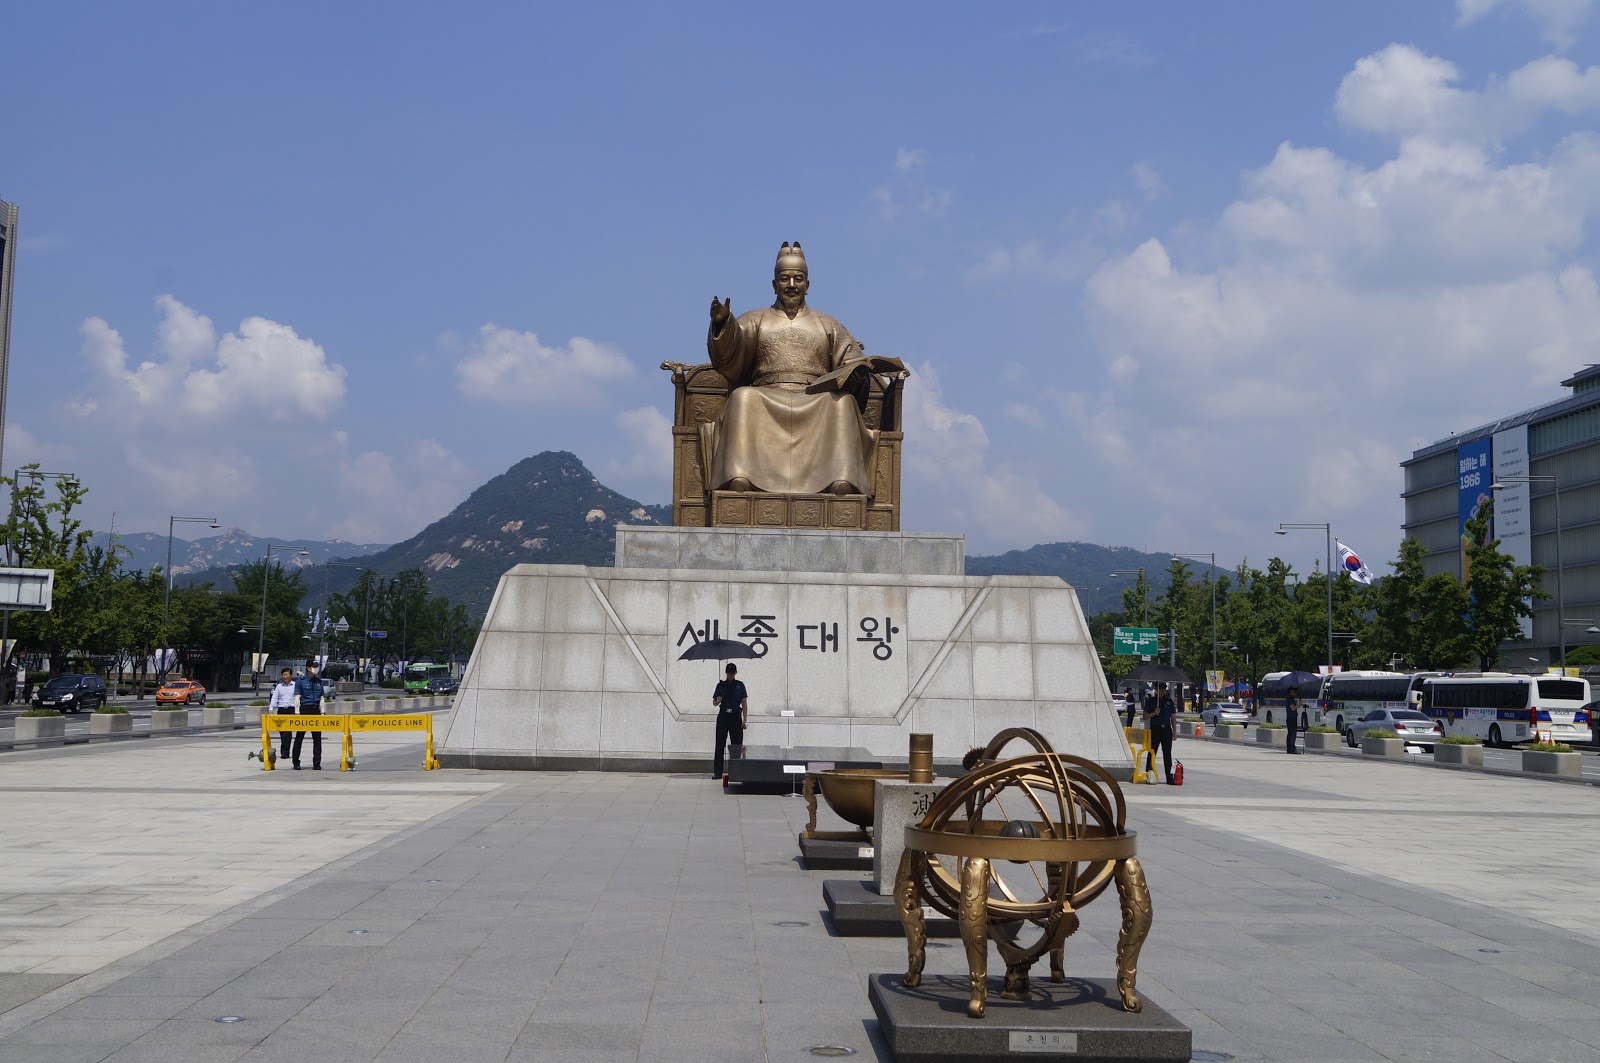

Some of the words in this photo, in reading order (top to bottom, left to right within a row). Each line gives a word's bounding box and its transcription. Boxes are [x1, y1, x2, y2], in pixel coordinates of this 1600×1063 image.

[1460, 457, 1478, 473] 일하는
[1480, 453, 1486, 467] 해
[1460, 472, 1480, 489] 1966
[677, 615, 899, 661] 세종대왕
[289, 719, 319, 727] POLICE
[322, 719, 340, 727] LINE
[372, 719, 402, 727] POLICE
